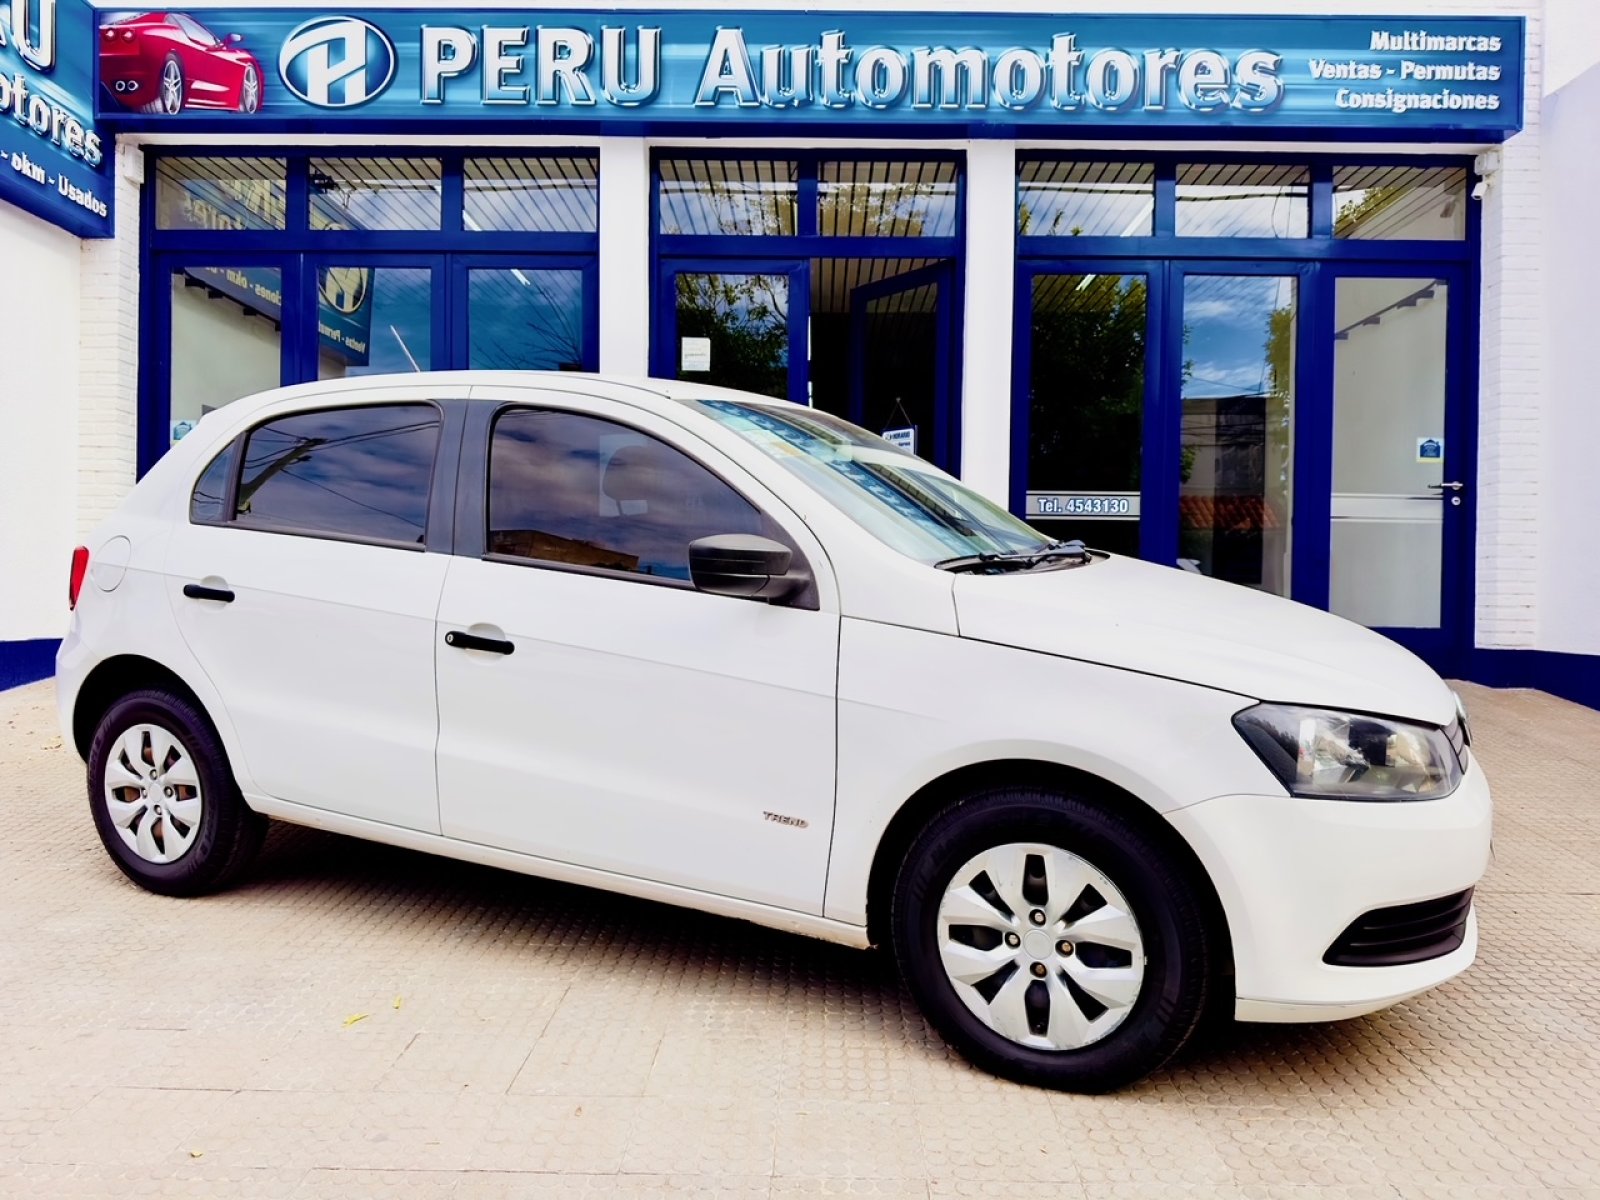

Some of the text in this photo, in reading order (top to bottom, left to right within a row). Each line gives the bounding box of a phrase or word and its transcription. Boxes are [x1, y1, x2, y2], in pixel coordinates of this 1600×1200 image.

[1370, 30, 1502, 51] Multimarcas
[420, 24, 1285, 113] PERU Automotores
[1308, 58, 1382, 80] Ventas
[1400, 60, 1501, 81] Permutas
[1335, 87, 1501, 113] Consignaciones
[58, 172, 108, 217] Usados
[1037, 497, 1130, 514] Tel. 4543130
[763, 810, 809, 829] TREND
